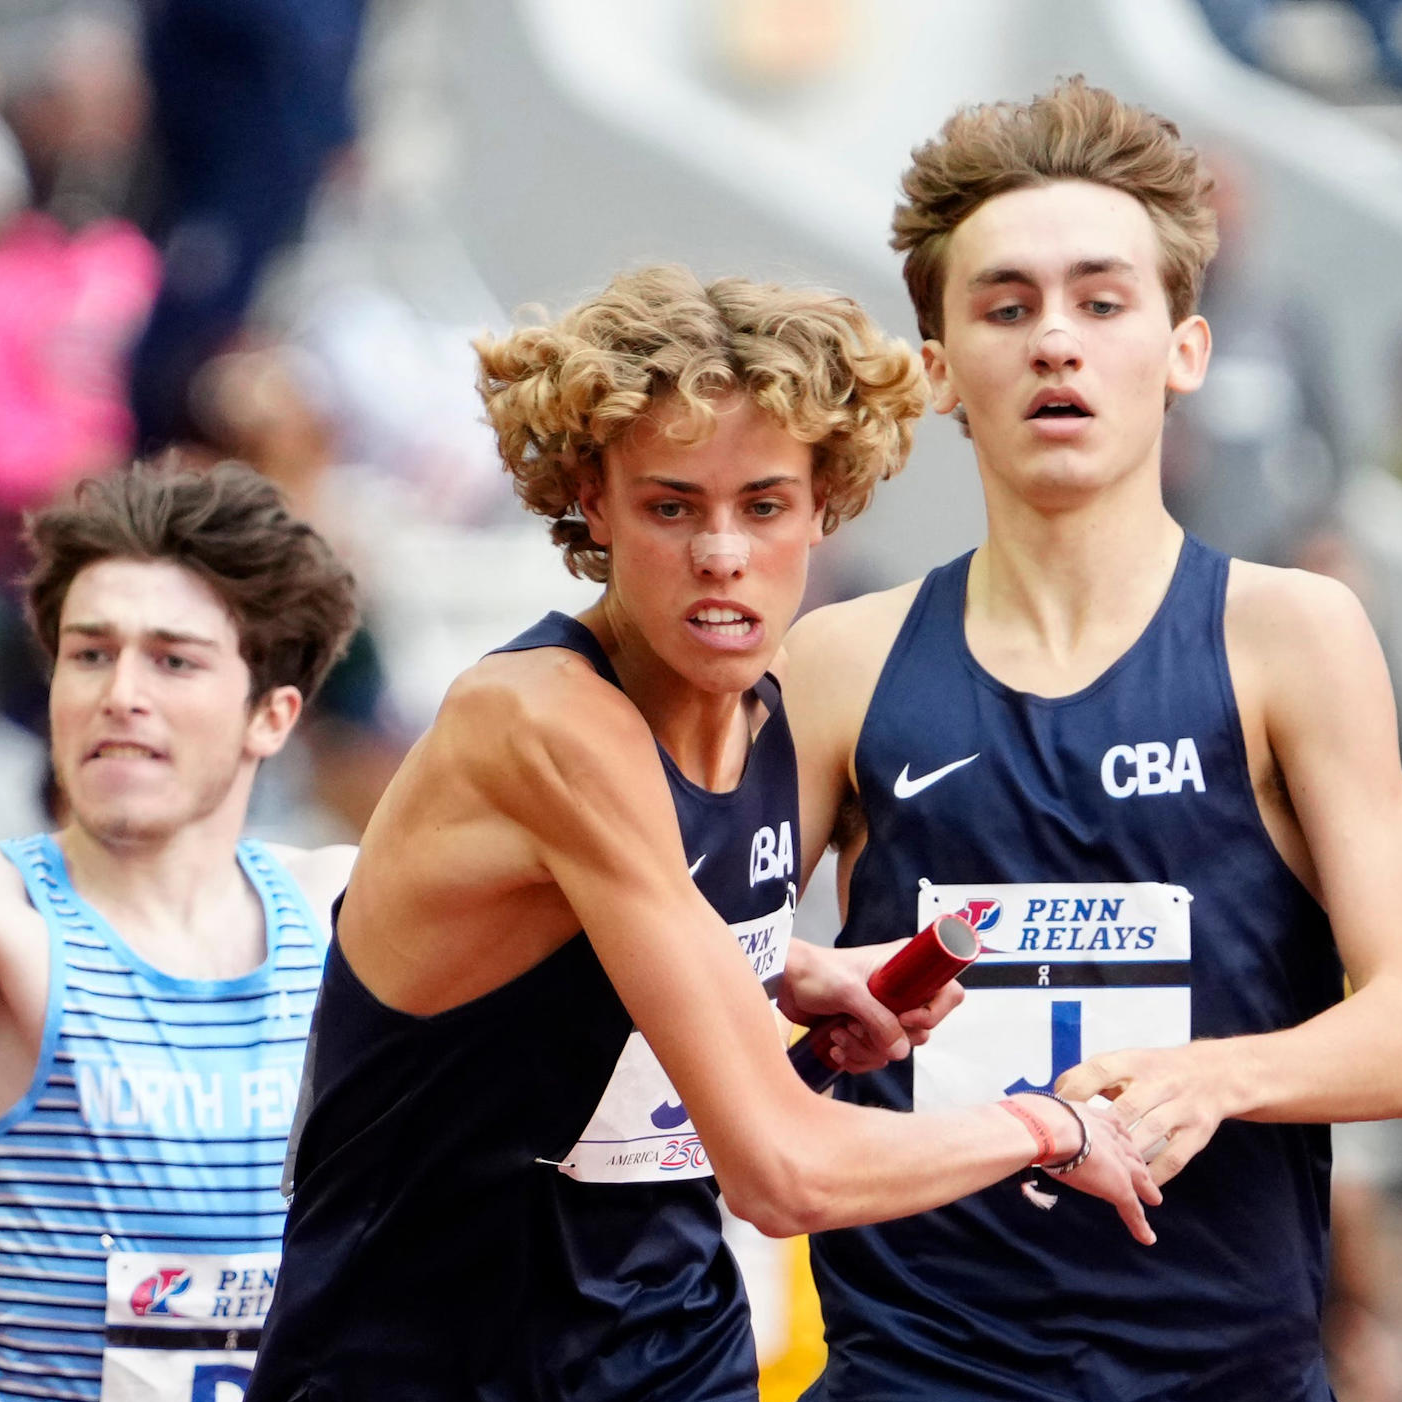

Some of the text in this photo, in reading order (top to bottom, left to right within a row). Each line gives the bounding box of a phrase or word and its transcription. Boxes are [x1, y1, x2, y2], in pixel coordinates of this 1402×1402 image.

[1101, 738, 1206, 799] CBA
[1023, 898, 1125, 922] PENN
[1017, 926, 1157, 951] RELAYS
[80, 1064, 305, 1130] NORTH PEN
[606, 1150, 660, 1166] AMERICA
[217, 1267, 280, 1291] PEN
[211, 1293, 267, 1318] REL
